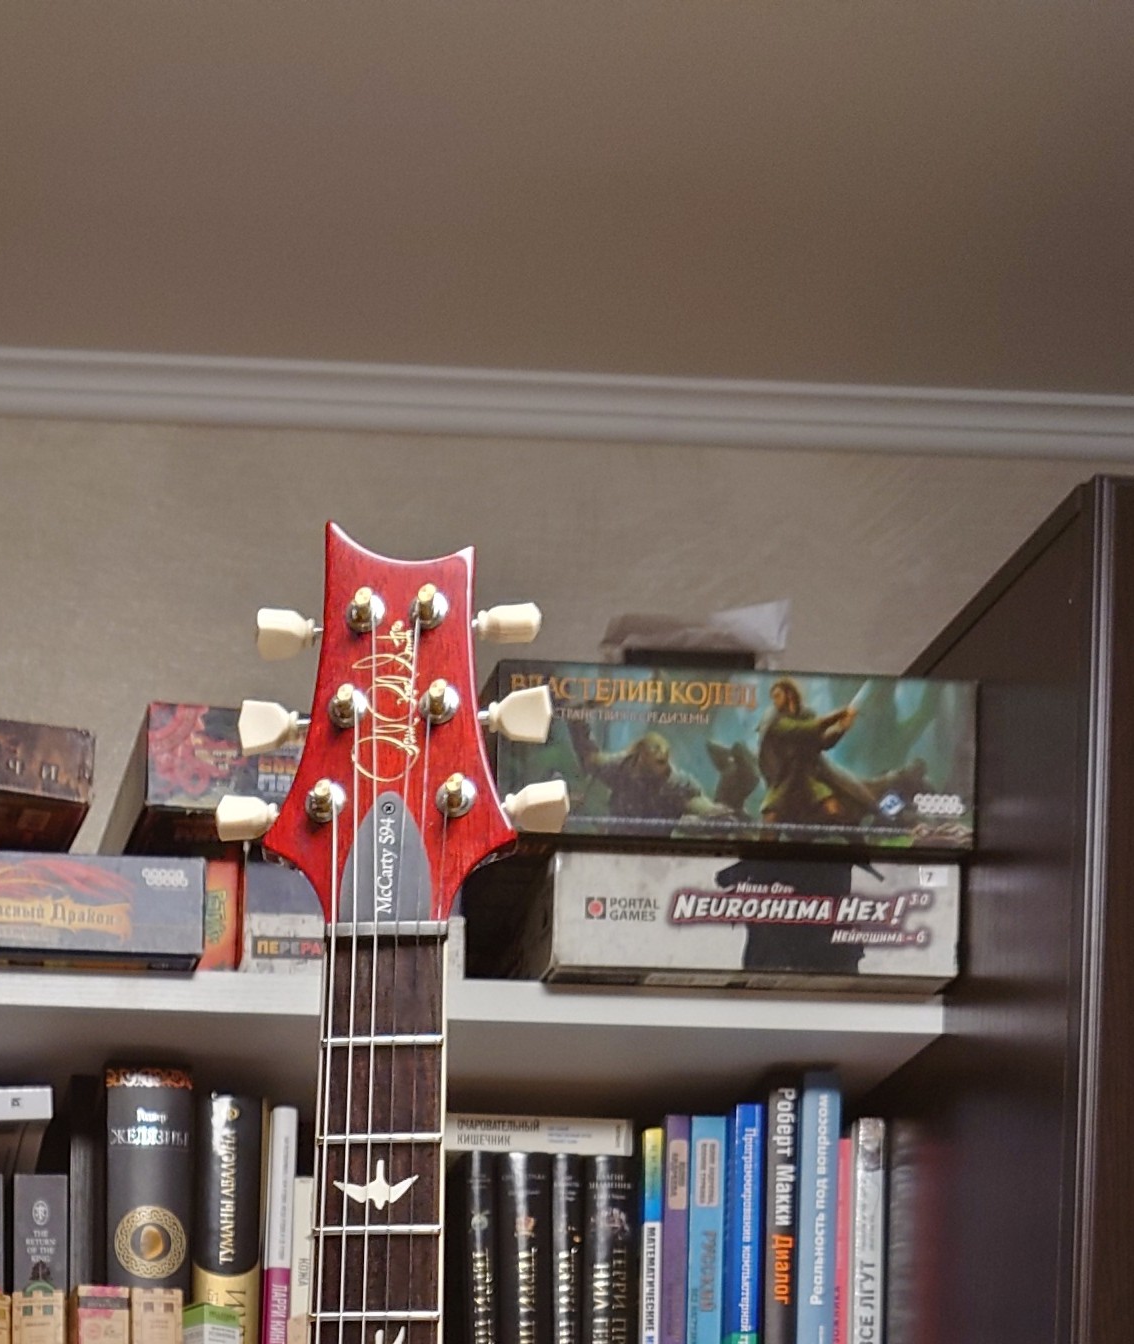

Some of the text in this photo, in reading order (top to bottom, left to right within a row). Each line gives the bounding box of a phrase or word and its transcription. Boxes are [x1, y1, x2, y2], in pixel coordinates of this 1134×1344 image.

[670, 681, 757, 709] КОЛЕЦ
[375, 849, 396, 915] McCarty
[609, 897, 660, 910] PORTAL
[609, 910, 657, 922] GAMES
[673, 893, 830, 921] NEUROSHIMA
[456, 1118, 540, 1132] ОЧАРОВАТЕЛЬНЫЙ
[456, 1134, 512, 1147] КИШЕЧНИК
[218, 1129, 238, 1198] АВАЛОНА
[740, 1126, 758, 1242] Программирование
[773, 1087, 797, 1306] Роберт Макки Диалог
[809, 1093, 831, 1306] Реальность под вопросом
[25, 1238, 56, 1246] RETURN
[26, 1246, 55, 1255] OF THE
[218, 1199, 236, 1265] ТУМАНЫ
[298, 1257, 310, 1287] КОЖА
[592, 1263, 610, 1311] НИЛ
[612, 1246, 627, 1310] ТЕРРИ
[644, 1226, 657, 1333] МАТЕМАТИЧЕСКИЕ
[739, 1244, 754, 1332] компьютерной
[858, 1259, 876, 1311] ЛГУТ
[271, 1282, 288, 1319] ЛАРРИ
